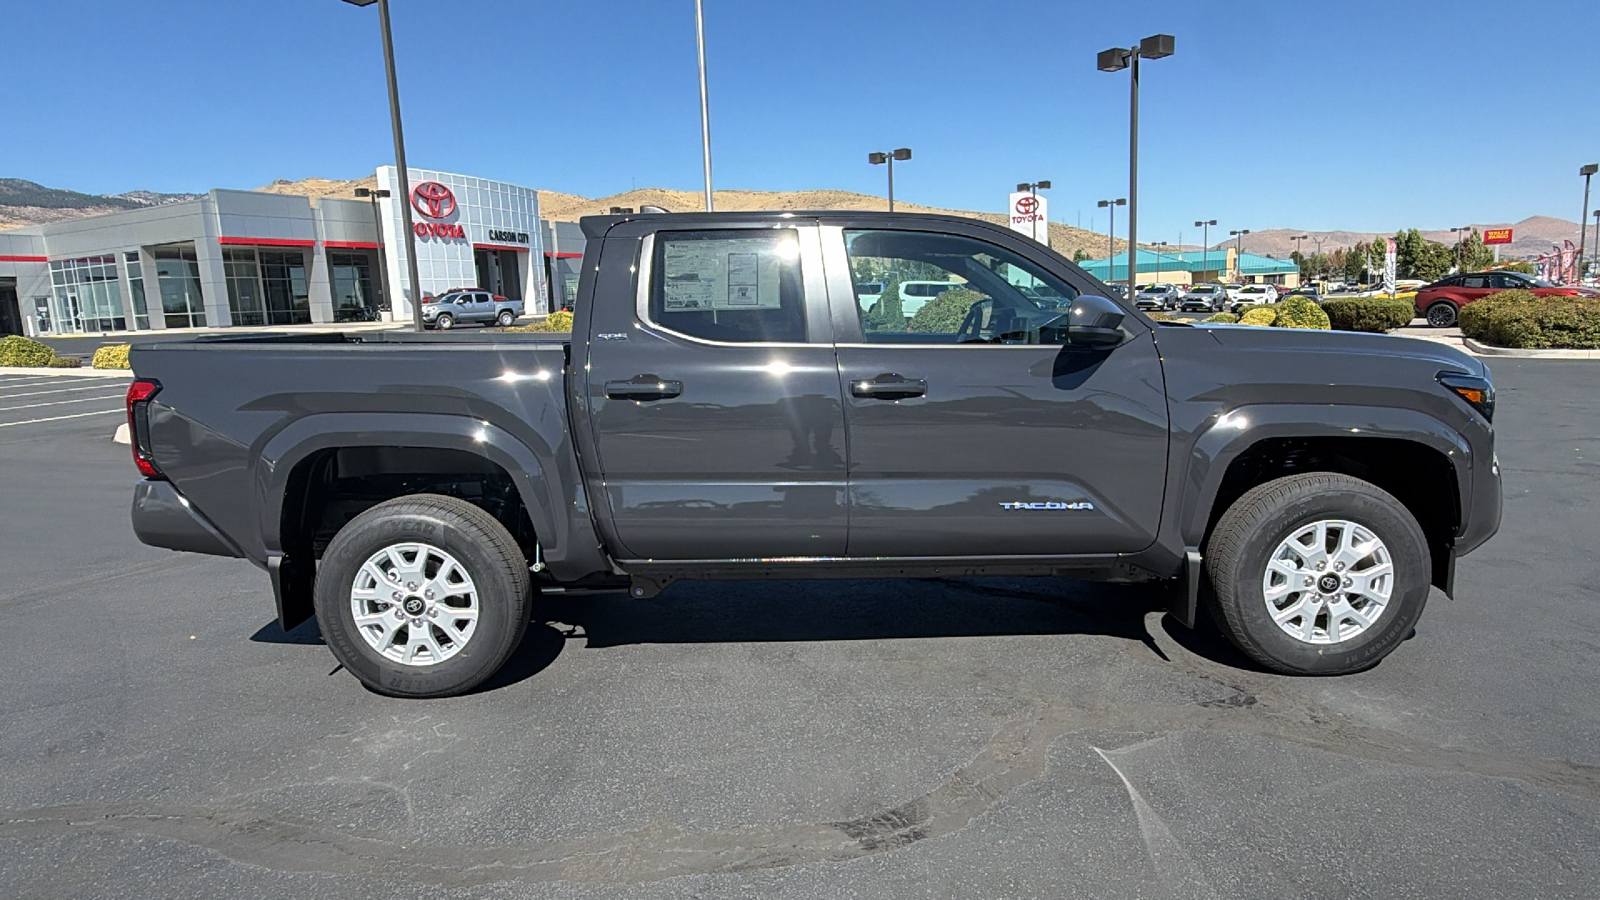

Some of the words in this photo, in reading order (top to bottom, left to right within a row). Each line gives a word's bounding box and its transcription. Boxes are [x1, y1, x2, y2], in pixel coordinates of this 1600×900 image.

[1012, 214, 1044, 224] TOYOTA
[413, 222, 466, 238] OYOTA
[489, 229, 517, 242] CARSON
[517, 232, 529, 243] CITY
[998, 501, 1093, 511] TACOMA
